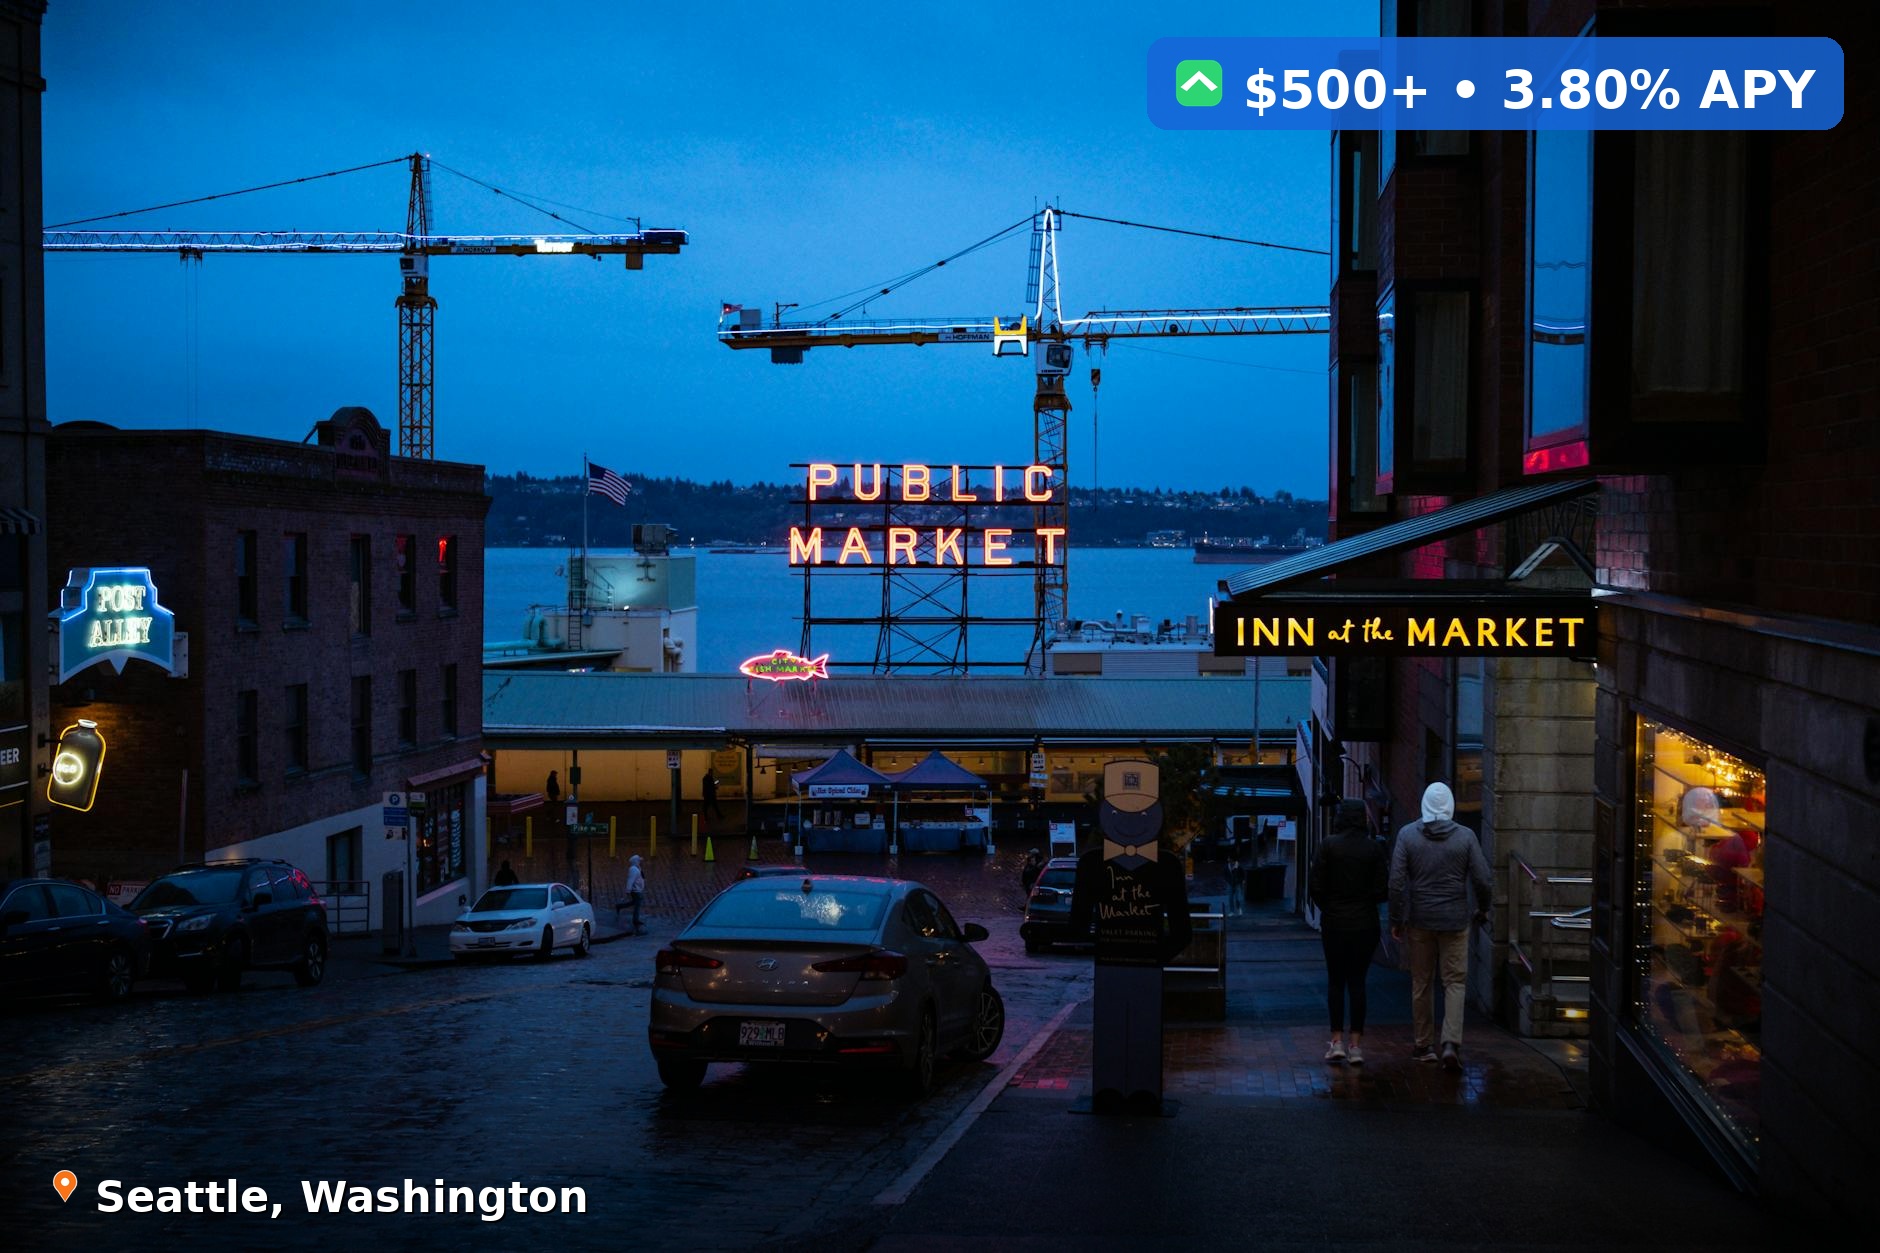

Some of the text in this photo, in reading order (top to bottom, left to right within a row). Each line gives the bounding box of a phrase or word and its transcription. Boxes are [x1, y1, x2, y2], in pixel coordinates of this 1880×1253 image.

[809, 463, 1053, 502] PUBLIC
[789, 526, 1066, 566] MARKET
[97, 585, 146, 612] POST
[88, 617, 153, 648] ALLEY
[1237, 617, 1585, 647] INN at the MARKET
[1107, 865, 1134, 889] Inn
[109, 886, 120, 895] NO
[1112, 883, 1152, 902] at the
[1098, 901, 1160, 920] Market
[741, 1026, 760, 1041] 929
